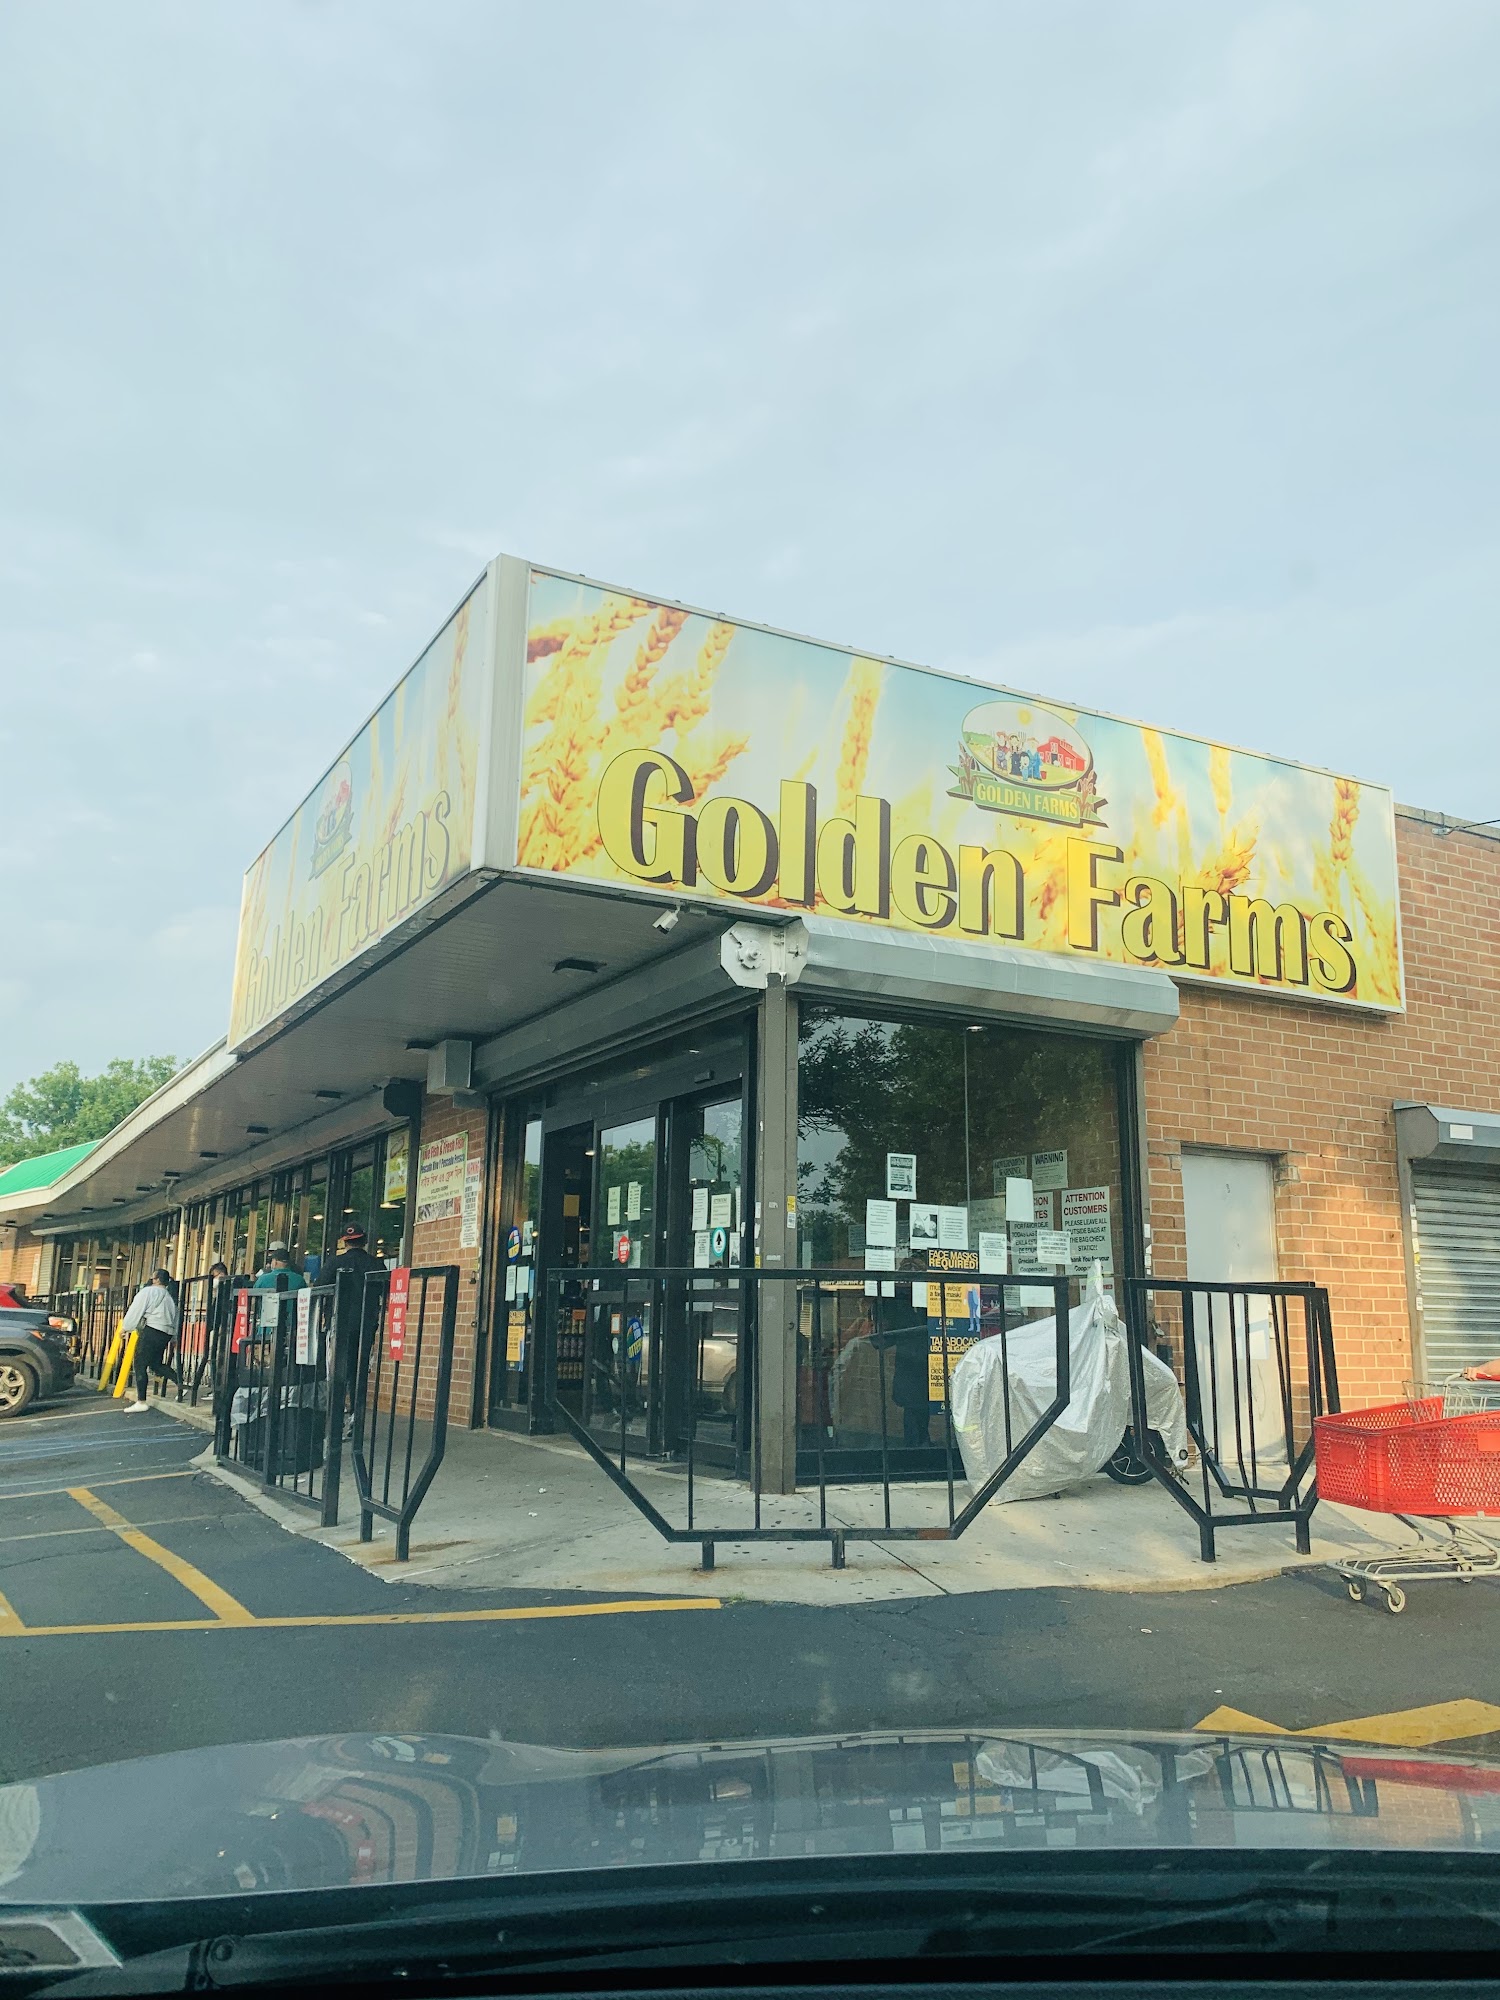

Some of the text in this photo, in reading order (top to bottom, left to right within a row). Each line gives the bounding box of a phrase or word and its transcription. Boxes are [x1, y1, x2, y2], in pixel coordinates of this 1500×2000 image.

[976, 783, 1078, 819] GOLDEN FARMS
[597, 748, 1357, 994] Golden Farms
[243, 790, 451, 1034] Golden Farms
[1034, 1152, 1064, 1165] WARNING
[1065, 1192, 1105, 1203] ATTENTION
[1064, 1204, 1108, 1216] CUSTOMERS
[1065, 1219, 1084, 1227] PLEASE
[1084, 1218, 1099, 1226] LEAVE
[929, 1250, 979, 1262] FACE MASKS
[929, 1259, 979, 1271] REQUIRED!
[390, 1291, 407, 1304] PARKING
